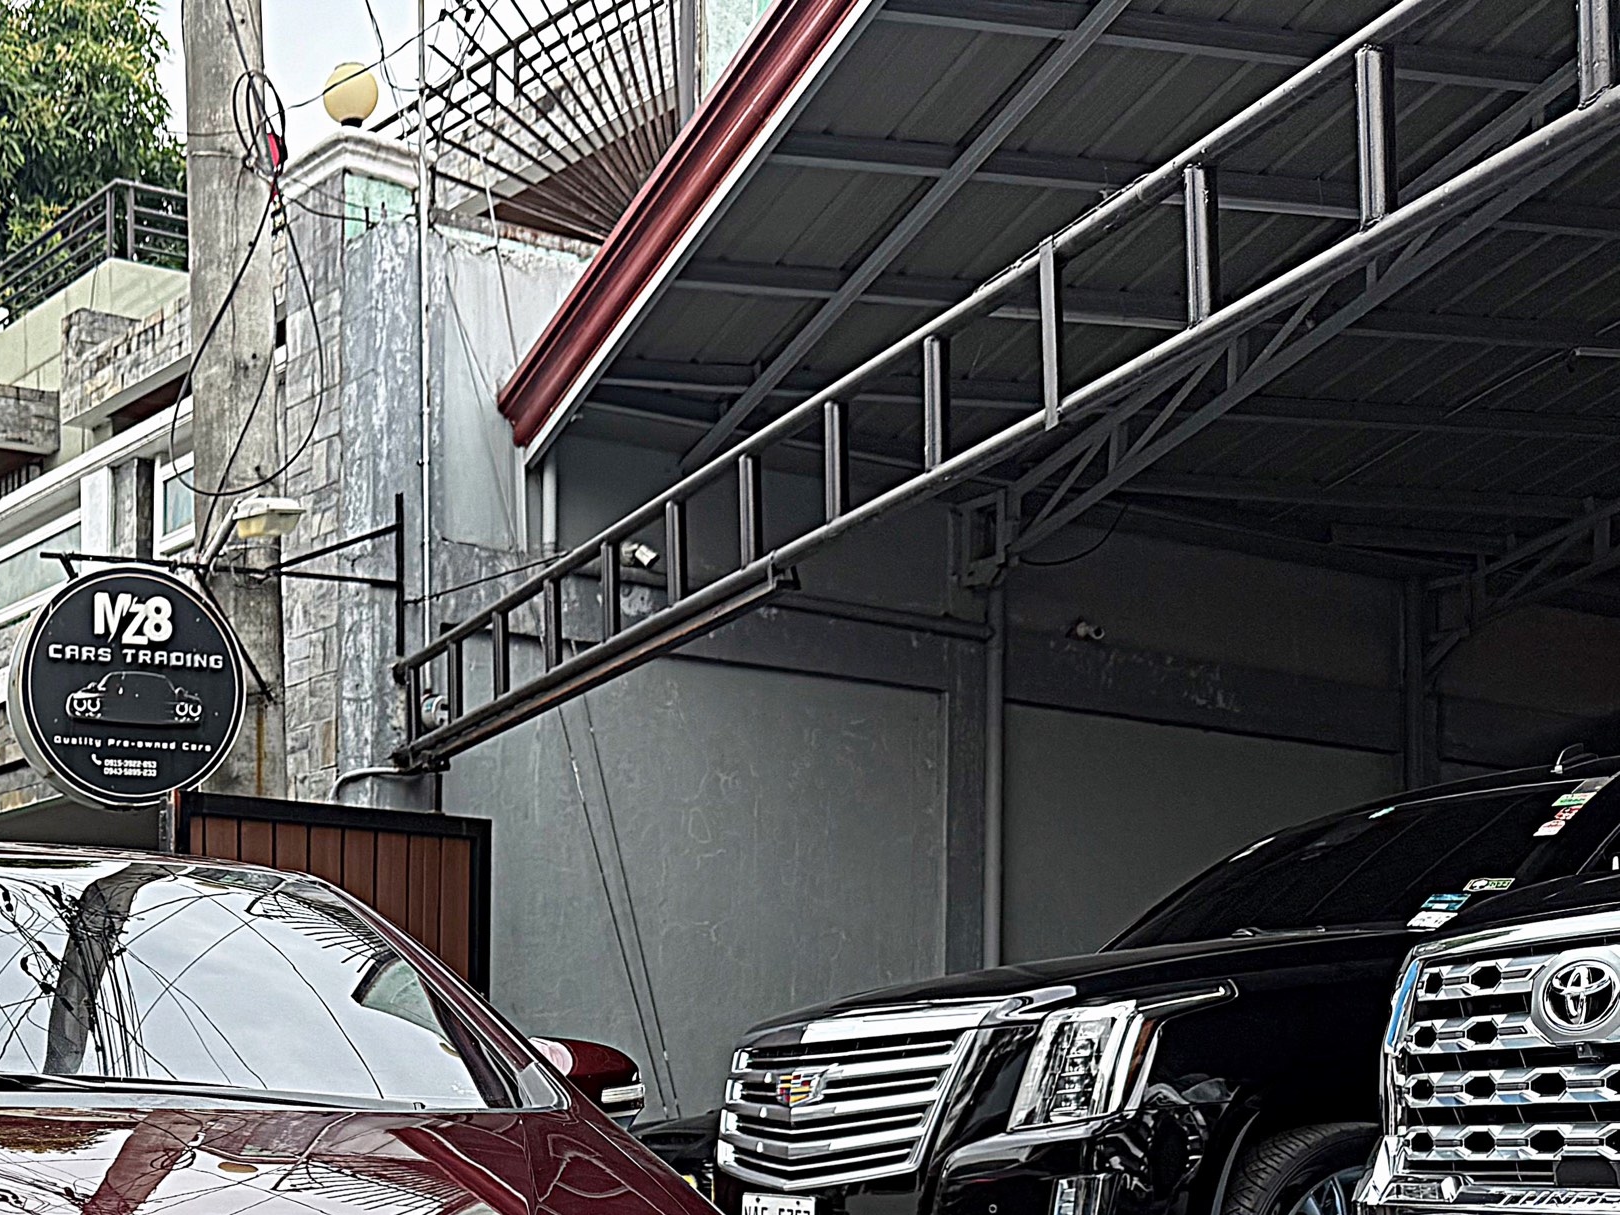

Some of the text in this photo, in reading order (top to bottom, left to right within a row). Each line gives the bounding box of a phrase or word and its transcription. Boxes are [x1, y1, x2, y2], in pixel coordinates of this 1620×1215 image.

[48, 643, 224, 669] CARS TRADING
[53, 735, 212, 752] Quality Pre-owned Cars
